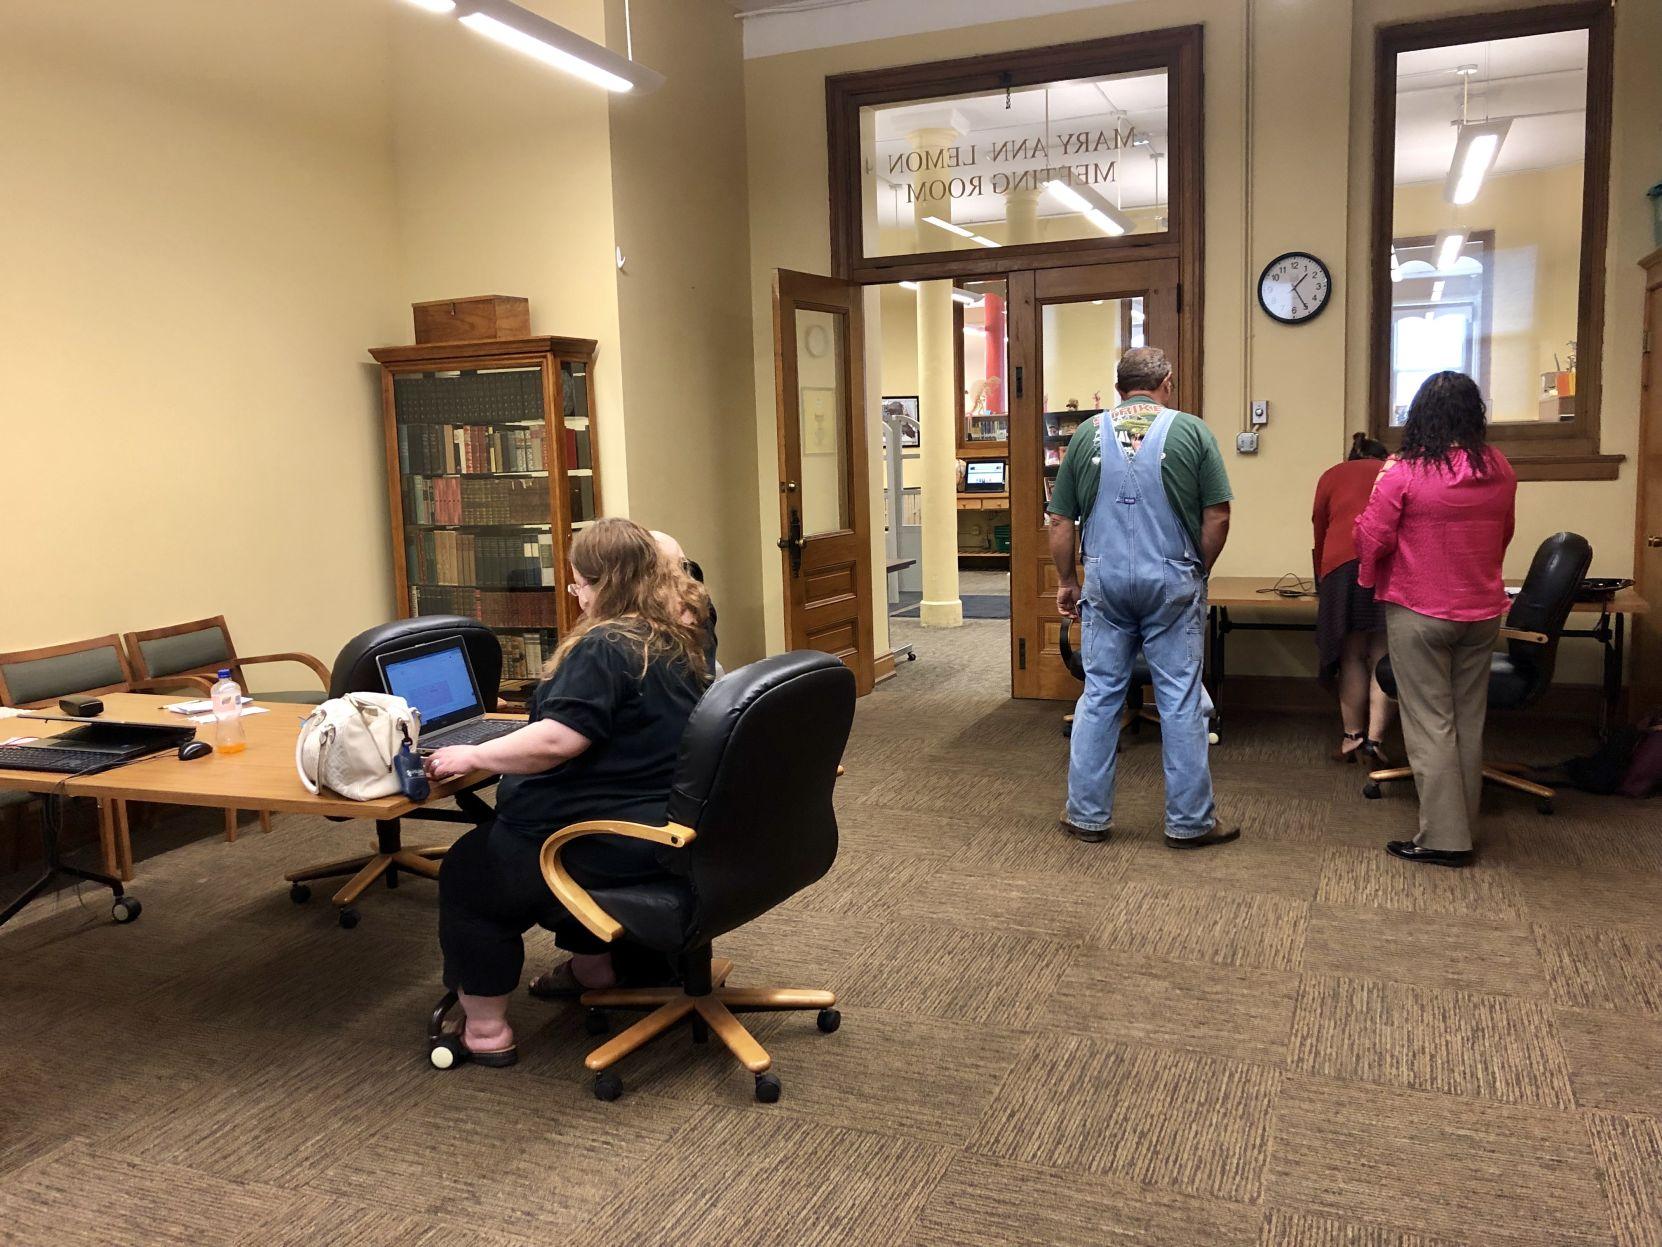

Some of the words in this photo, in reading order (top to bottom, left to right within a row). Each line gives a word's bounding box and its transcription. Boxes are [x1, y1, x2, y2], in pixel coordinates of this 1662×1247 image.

[1291, 261, 1299, 270] 12
[1280, 266, 1287, 274] 11
[1272, 273, 1280, 282] 10
[1312, 271, 1318, 279] 2
[1315, 282, 1322, 290] 3
[1291, 306, 1297, 314] 6
